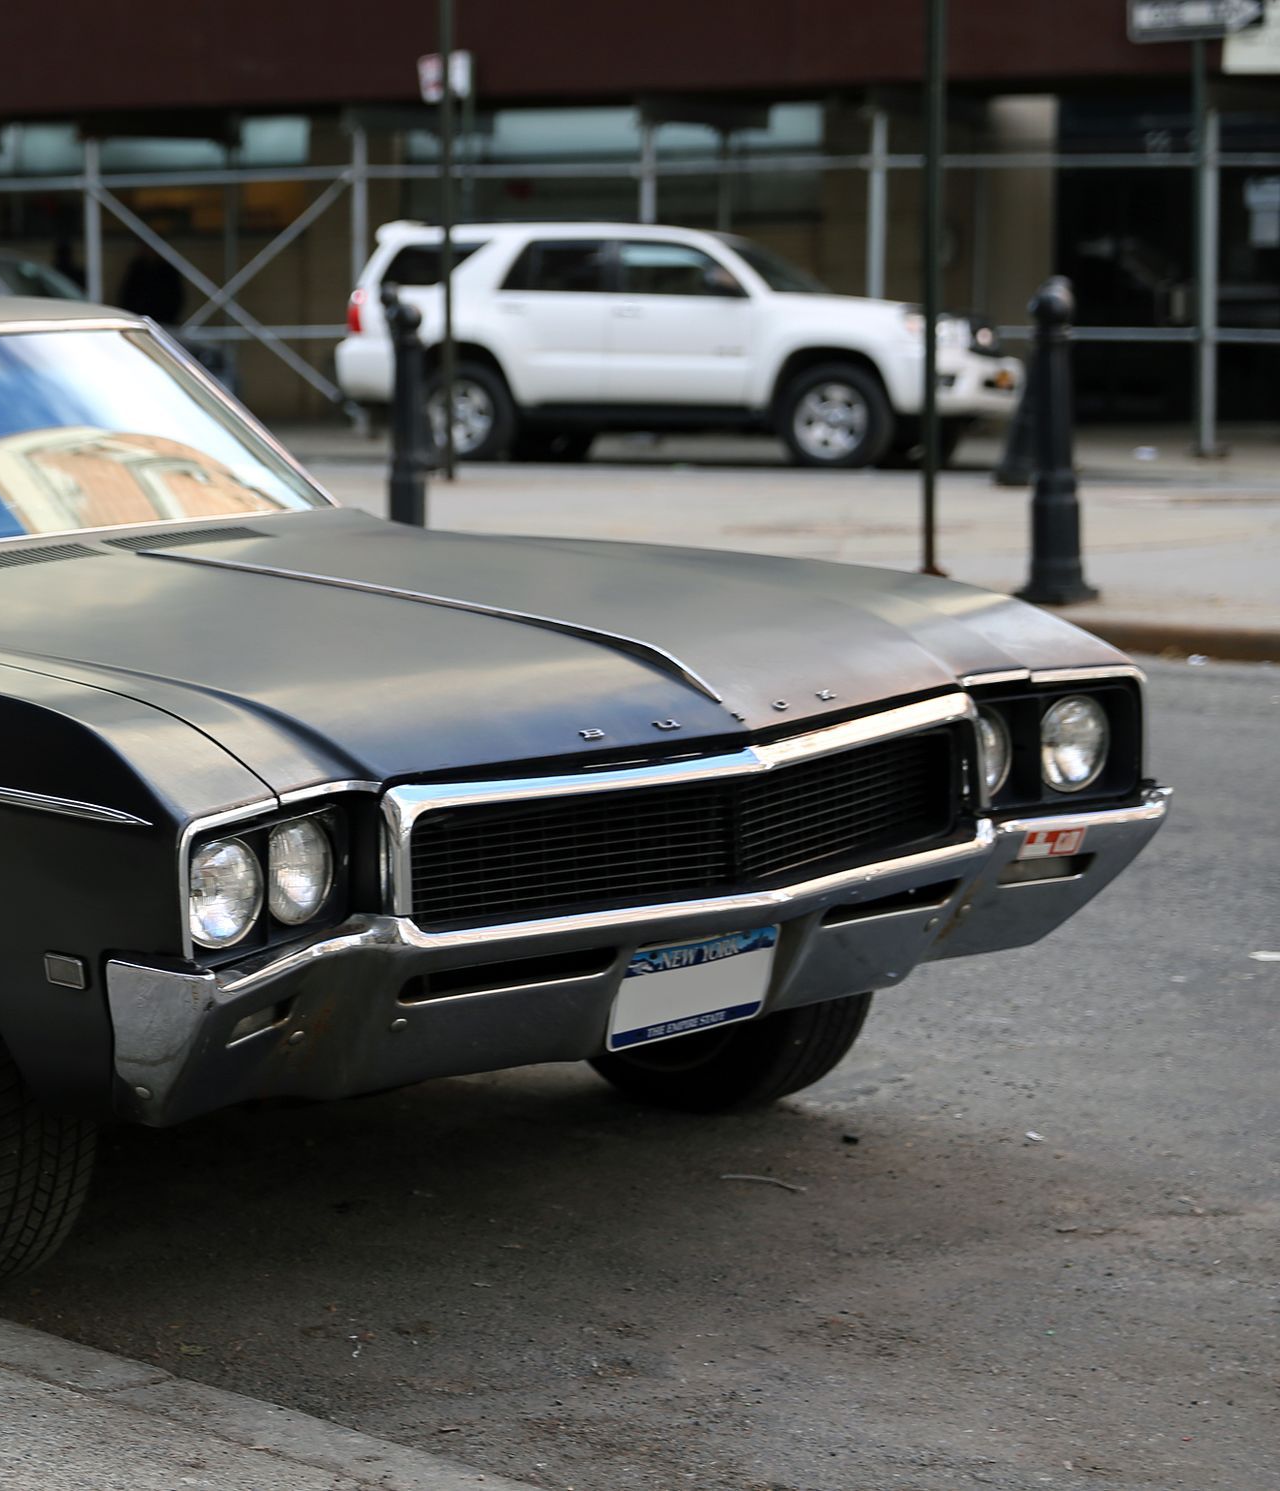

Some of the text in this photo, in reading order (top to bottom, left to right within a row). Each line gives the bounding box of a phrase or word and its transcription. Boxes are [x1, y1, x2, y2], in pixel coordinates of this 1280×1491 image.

[659, 938, 739, 970] NEW YORK
[647, 1011, 726, 1038] THE EMPIRE STATE
